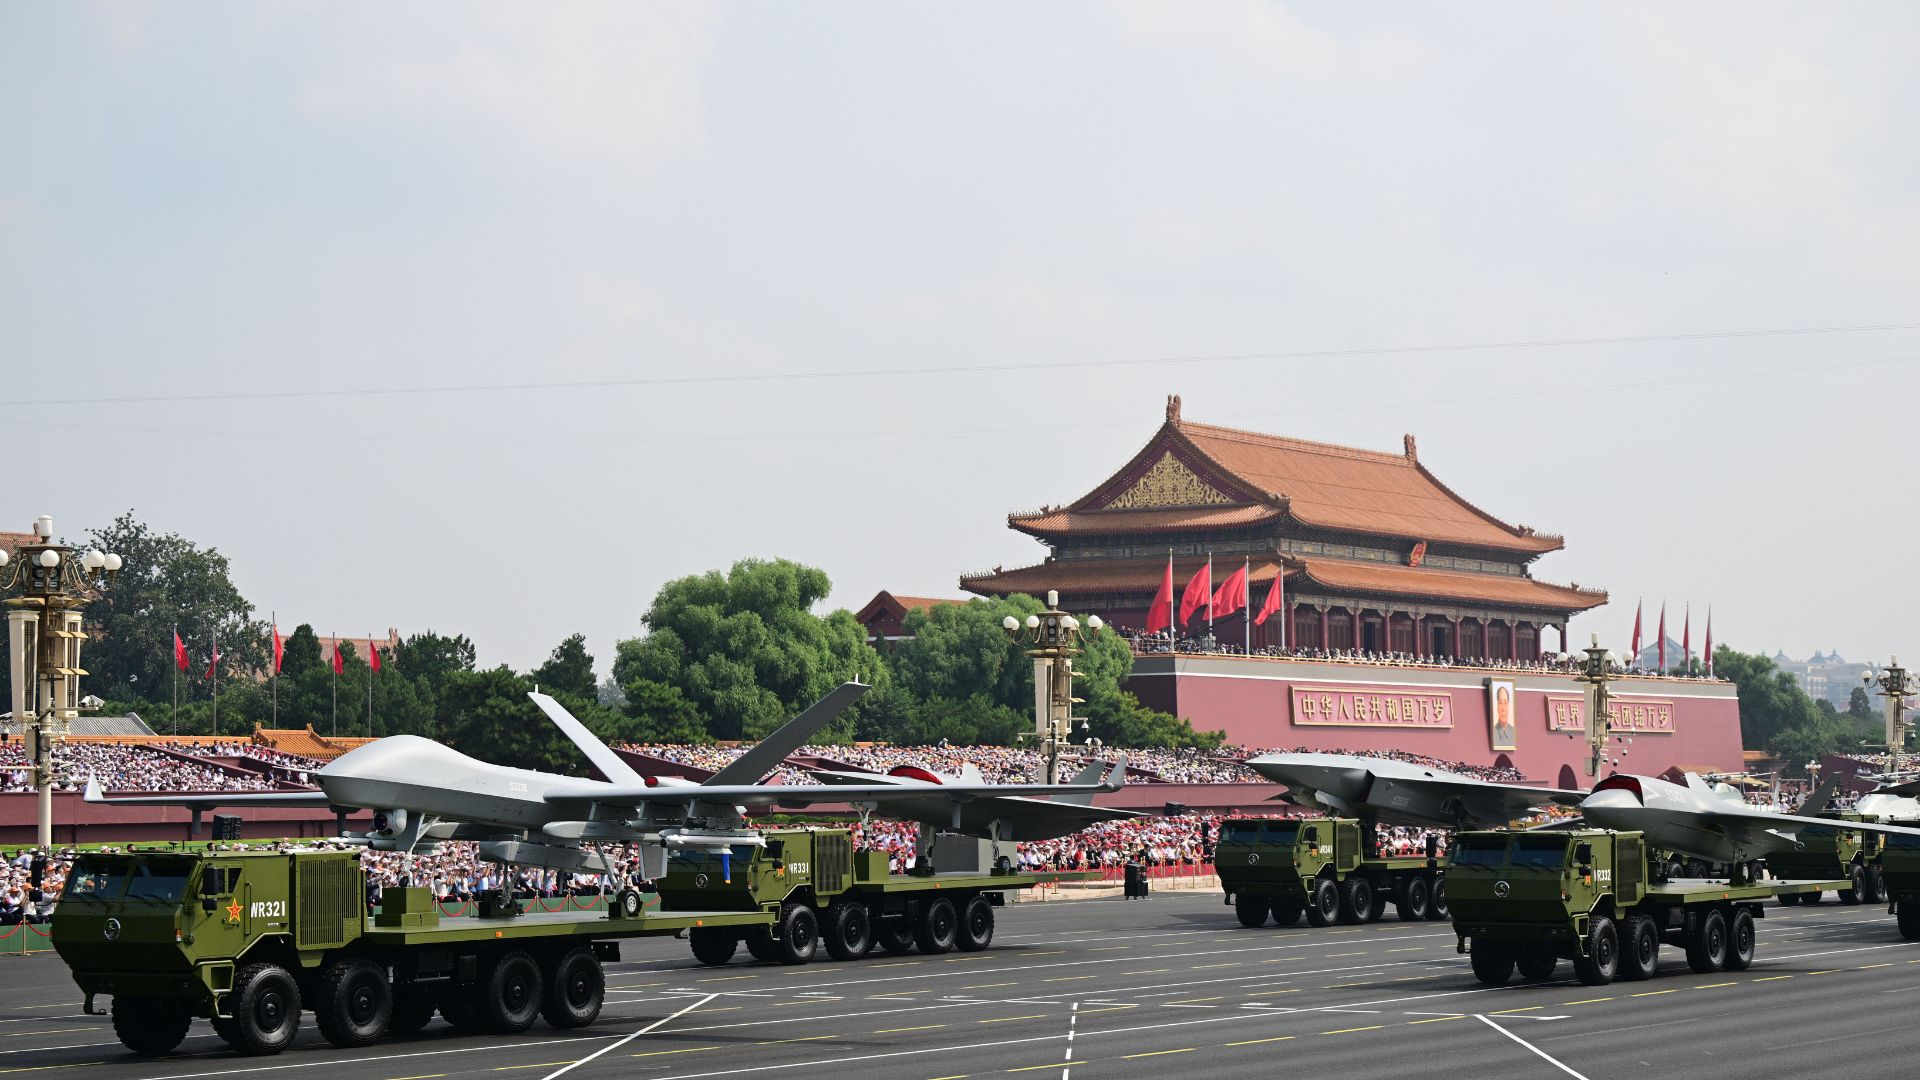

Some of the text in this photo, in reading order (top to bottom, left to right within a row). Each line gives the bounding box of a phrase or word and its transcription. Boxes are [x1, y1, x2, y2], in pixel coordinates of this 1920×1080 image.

[1302, 694, 1444, 722] 中华人民共和国万岁
[1556, 703, 1668, 728] 世界大团结万岁
[788, 862, 809, 874] WR331
[250, 900, 286, 918] WR321
